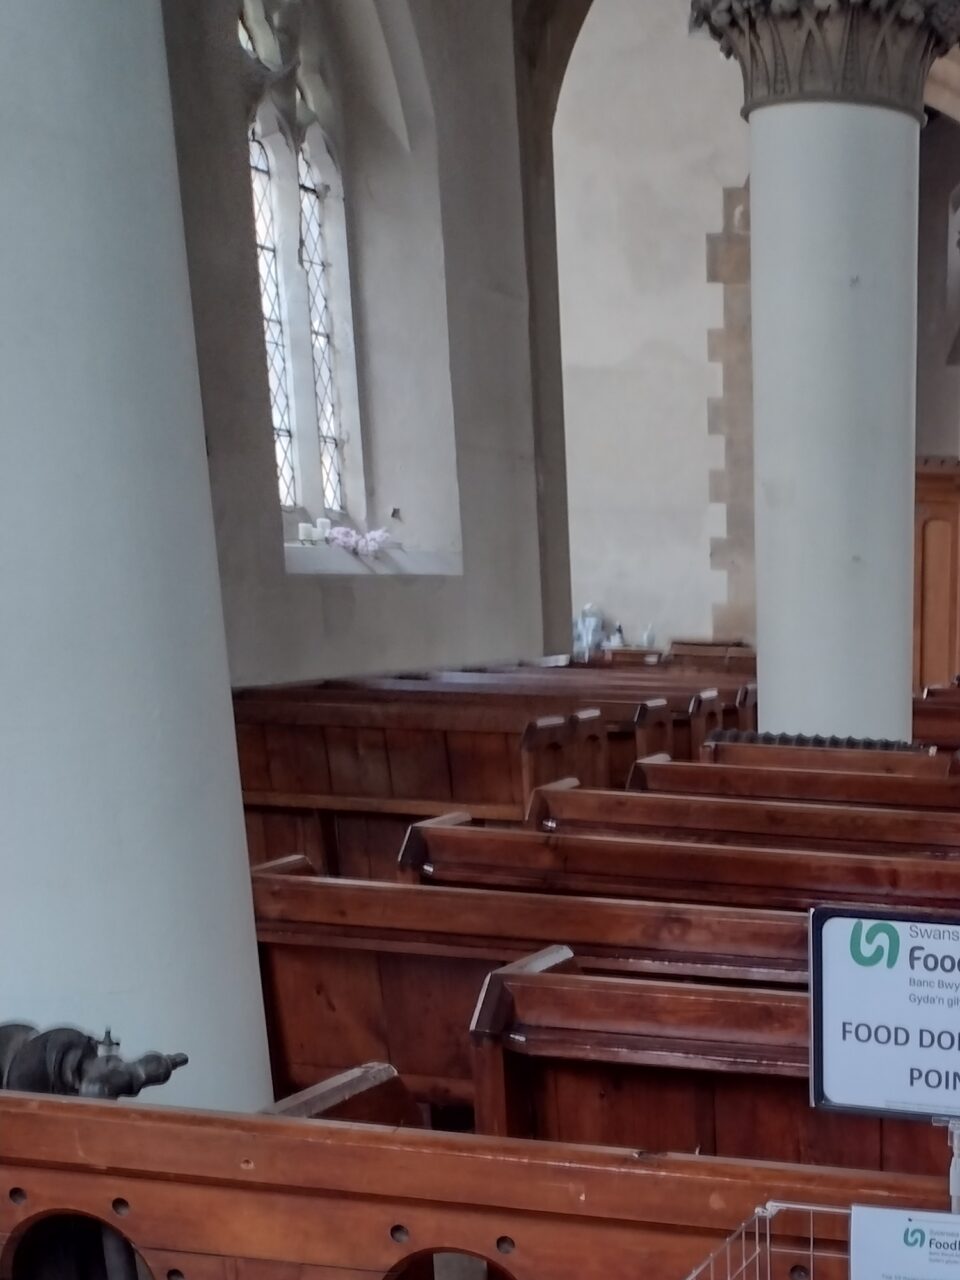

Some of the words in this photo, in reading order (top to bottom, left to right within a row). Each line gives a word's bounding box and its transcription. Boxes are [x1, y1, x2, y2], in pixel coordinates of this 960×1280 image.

[909, 978, 935, 988] Banc
[909, 993, 944, 1006] Gyda'n
[842, 1021, 910, 1046] FOOD
